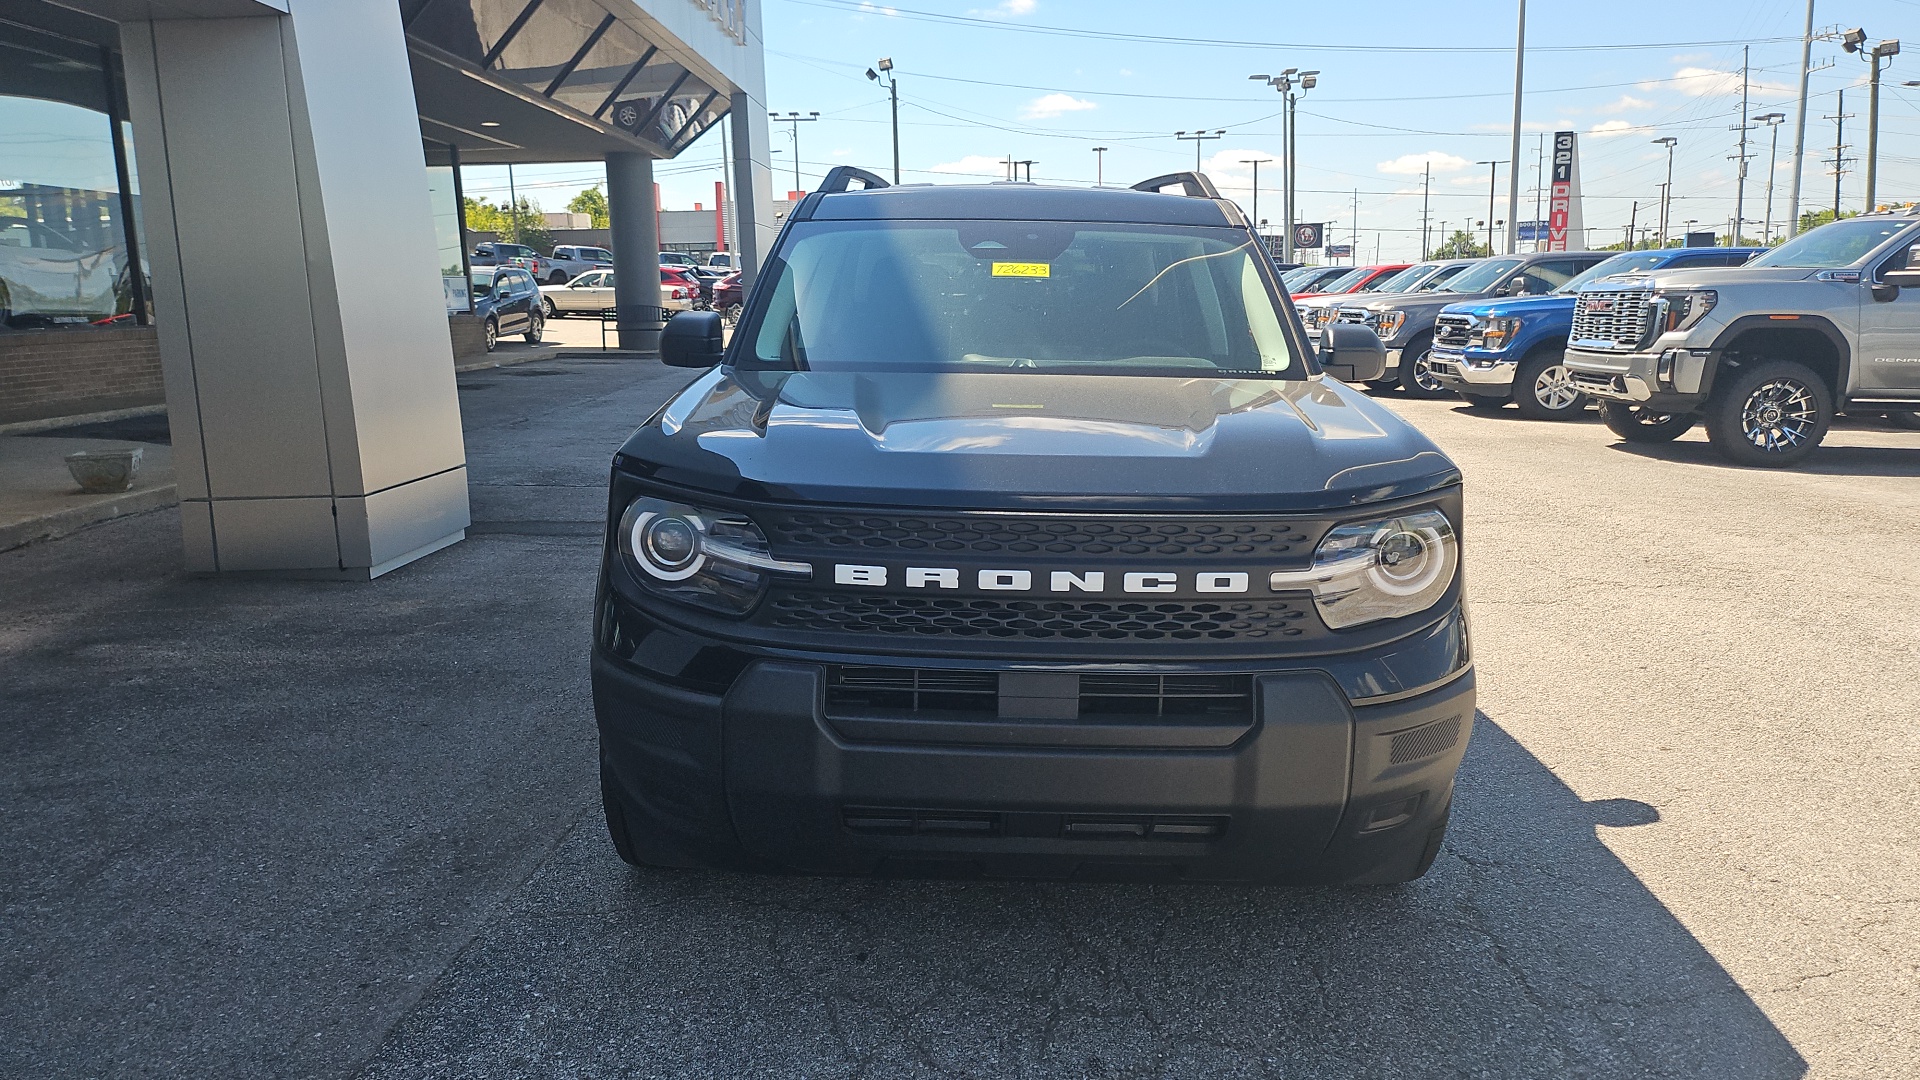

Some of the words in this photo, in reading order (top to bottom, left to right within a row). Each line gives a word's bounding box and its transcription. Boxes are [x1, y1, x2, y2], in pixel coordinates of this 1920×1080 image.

[1556, 136, 1572, 179] 321
[1550, 185, 1570, 252] DRIVE
[834, 563, 1250, 594] BRONCO
